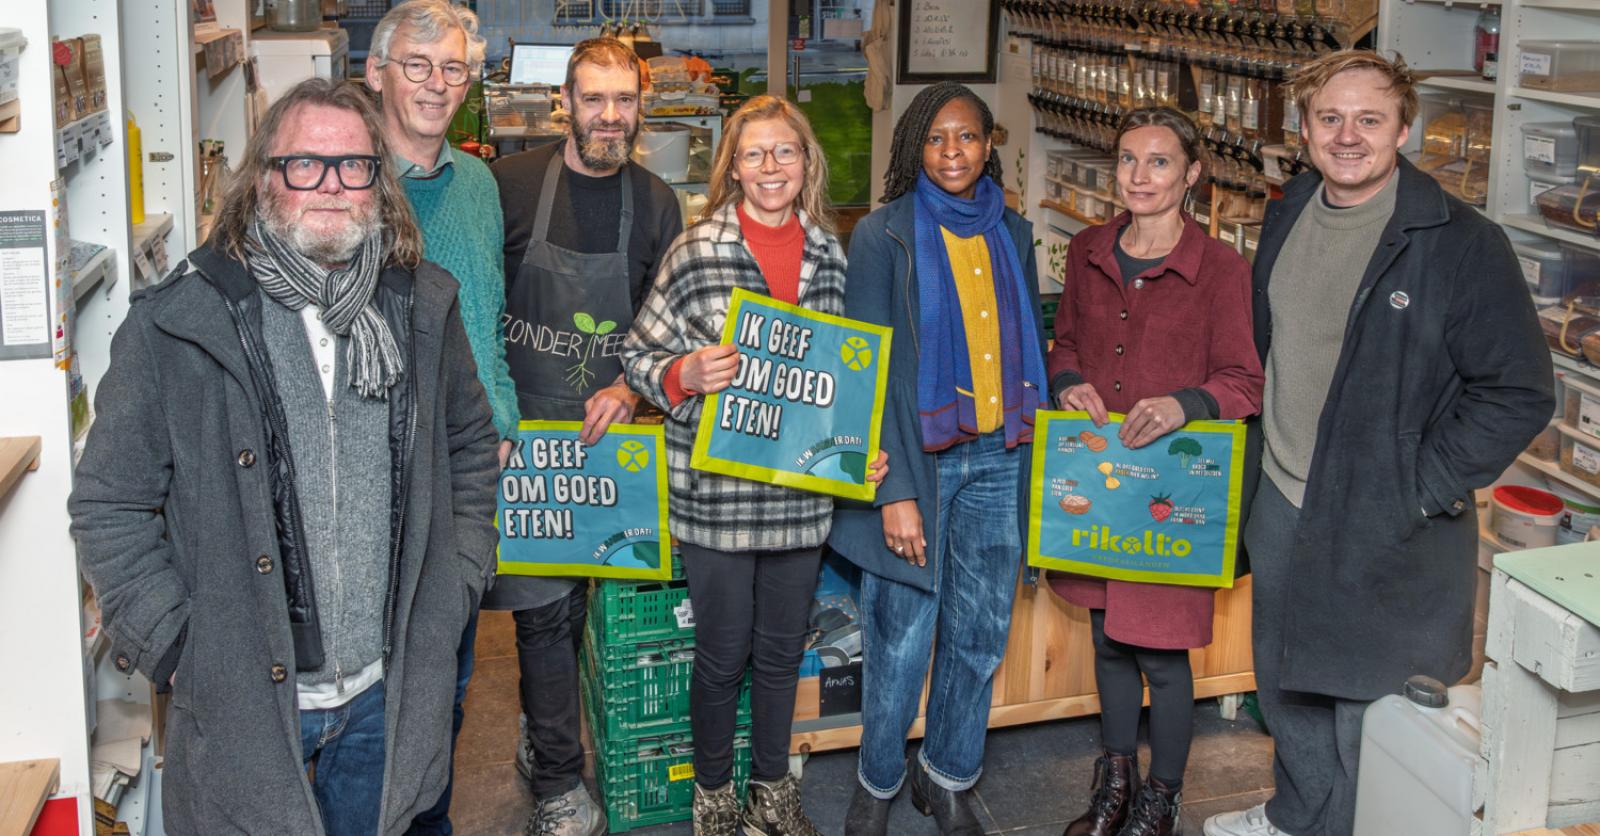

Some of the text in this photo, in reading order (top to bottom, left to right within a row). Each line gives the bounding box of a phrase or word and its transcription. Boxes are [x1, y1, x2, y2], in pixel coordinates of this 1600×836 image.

[502, 313, 628, 359] ZONDER MEE
[738, 311, 813, 361] IK GEEF
[731, 353, 836, 408] OM GOED
[719, 394, 782, 440] ETEN!
[509, 438, 588, 469] K GEEF
[502, 474, 618, 508] OM GOED
[504, 508, 575, 540] ETEN!
[1072, 524, 1192, 558] rikolto
